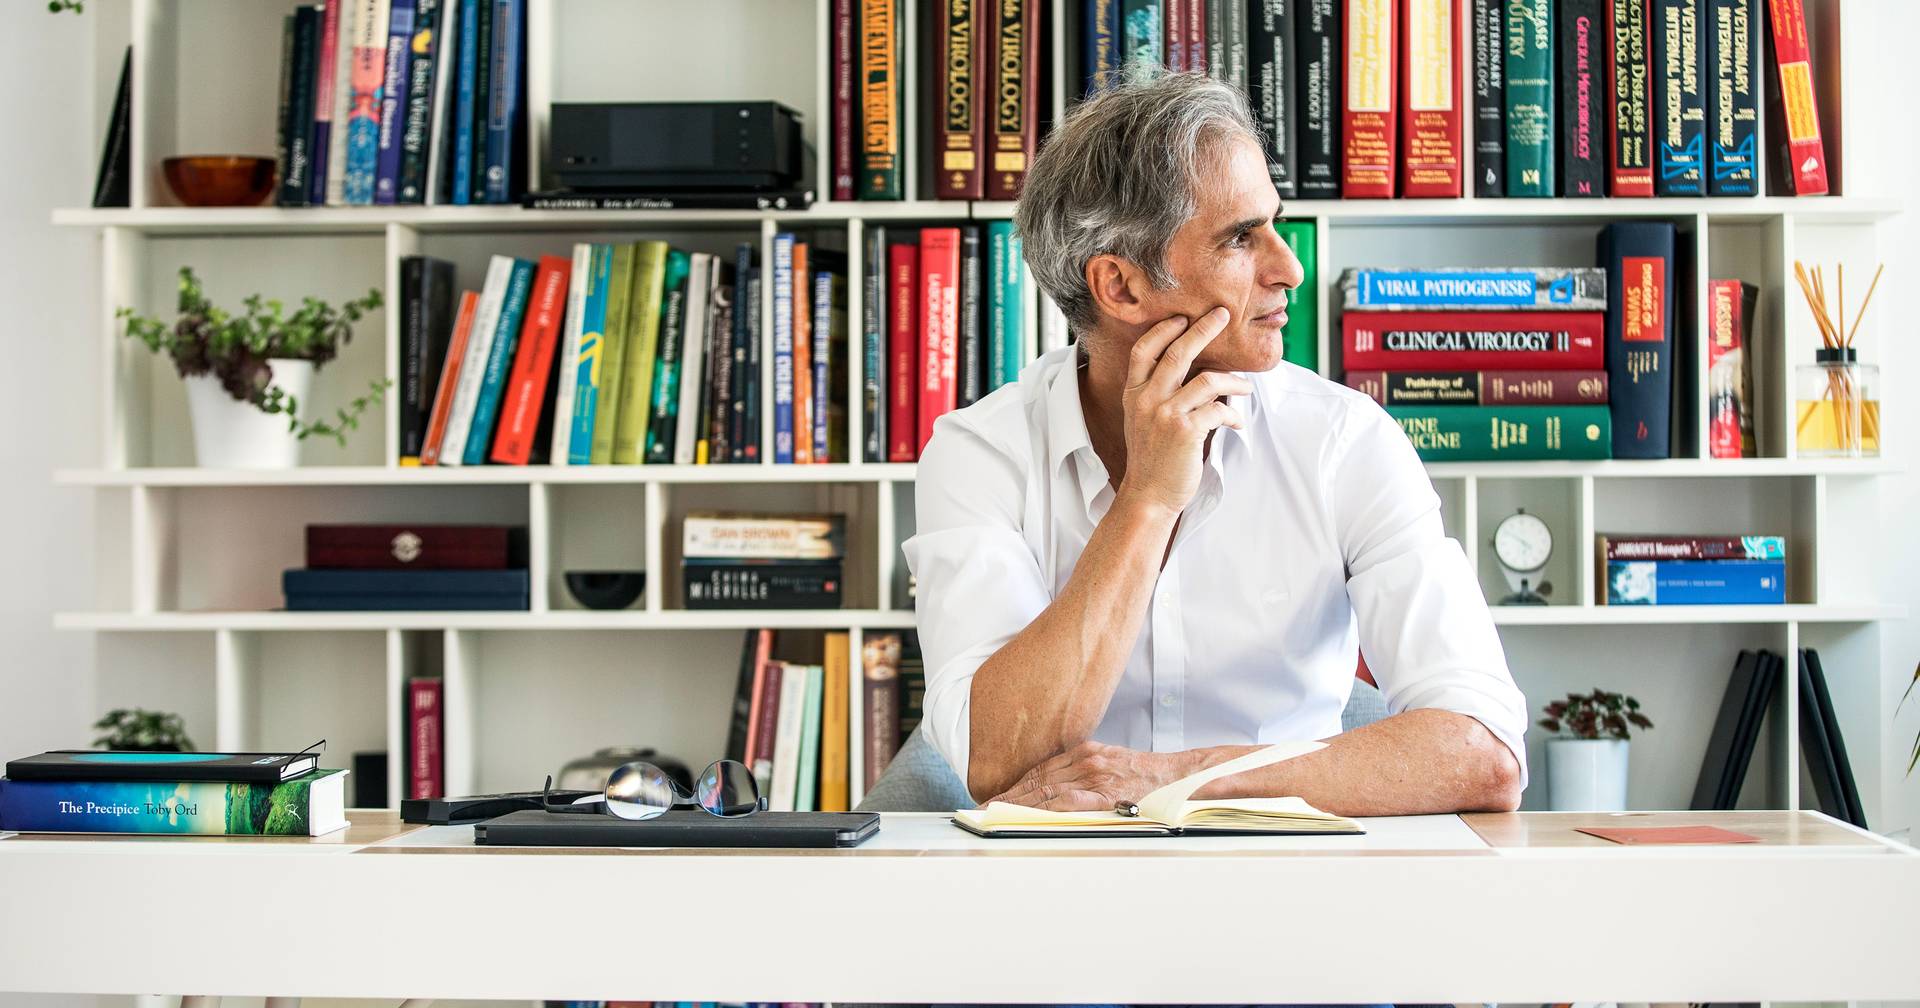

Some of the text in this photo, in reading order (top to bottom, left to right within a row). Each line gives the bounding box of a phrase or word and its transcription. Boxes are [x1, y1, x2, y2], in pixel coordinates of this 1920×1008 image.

[949, 21, 969, 128] VIROLOGY
[1002, 22, 1020, 129] VIROLOGY
[1476, 0, 1488, 97] EPIDEMIOLOGY
[1489, 8, 1501, 88] VETERINARY
[1616, 27, 1631, 63] DOG
[1666, 7, 1682, 148] INTERNAL MEDICINE
[1682, 7, 1698, 95] VETERINARY
[1718, 7, 1734, 148] INTERNAL MEDICINE
[1734, 7, 1749, 95] VETERINARY
[868, 82, 889, 153] VIROLOGY
[1262, 61, 1274, 117] VIROLOGY
[1308, 61, 1321, 117] VIROLOGY
[1577, 16, 1592, 160] GENERAL MICROBIOLOGY
[1630, 64, 1646, 133] DISEASES
[994, 233, 1004, 305] VETERINARY
[1377, 279, 1532, 297] VIRAL PATHOGENESIS
[1641, 263, 1653, 329] DISEASES OF
[926, 273, 940, 391] LABORATORY MOUSE
[1387, 331, 1465, 350] CLINICAL
[1467, 331, 1550, 350] VIROLOGY
[1626, 286, 1642, 337] SWINE
[1715, 286, 1733, 347] LARSSON
[1393, 388, 1475, 399] Domestic Animals
[1405, 377, 1463, 389] Pathology of
[59, 801, 198, 817] The Precipice Toby Ord
